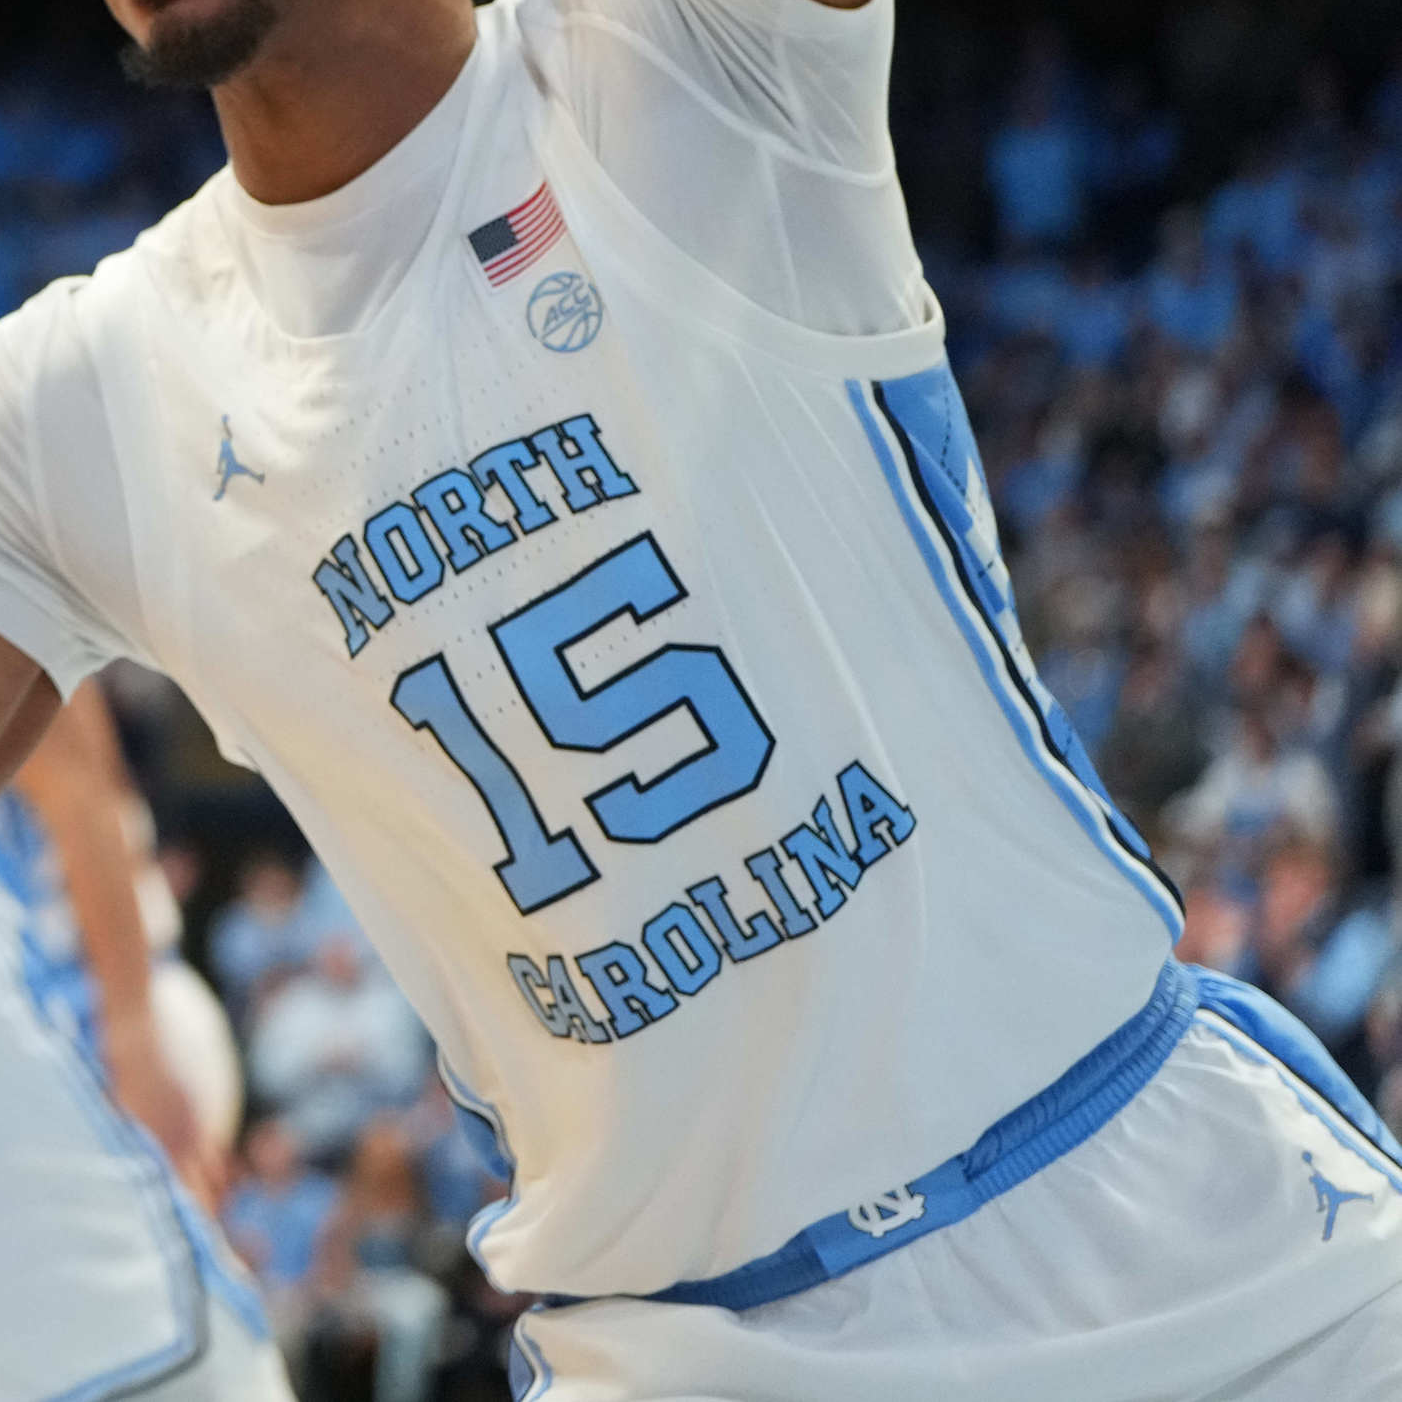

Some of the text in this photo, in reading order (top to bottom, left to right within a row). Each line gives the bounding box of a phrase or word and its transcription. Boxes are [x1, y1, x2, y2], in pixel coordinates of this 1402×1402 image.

[312, 413, 641, 659] NORTH
[389, 529, 777, 917] 15
[507, 759, 917, 1044] CAROLINA
